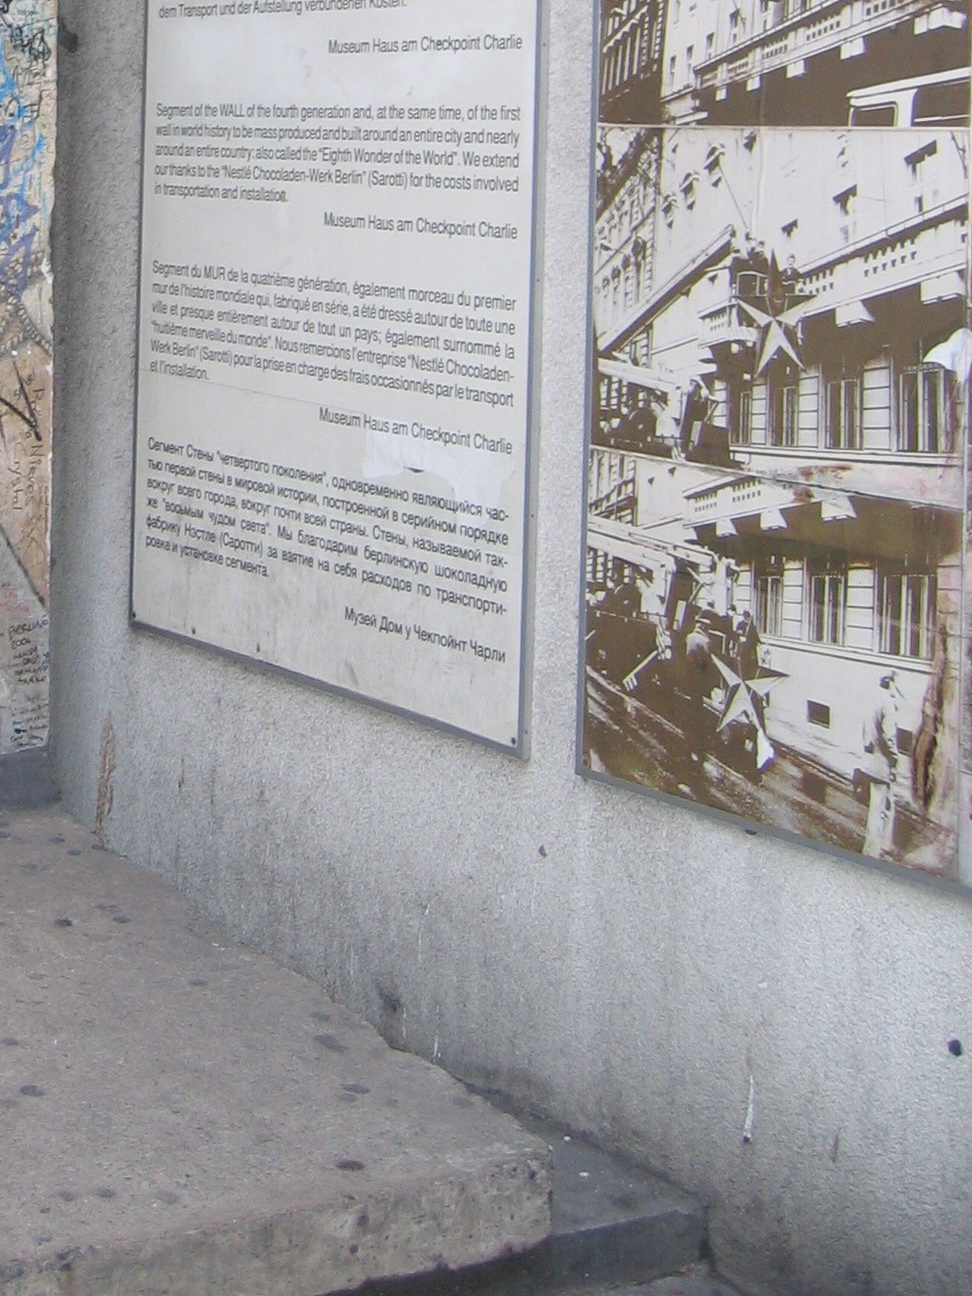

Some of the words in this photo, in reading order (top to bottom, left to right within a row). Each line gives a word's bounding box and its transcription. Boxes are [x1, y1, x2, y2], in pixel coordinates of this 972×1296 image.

[158, 5, 176, 18] dem
[178, 3, 218, 19] Transport
[219, 1, 235, 15] und
[237, 1, 252, 14] der
[252, 0, 302, 15] Aufstellung
[328, 39, 370, 53] Museum
[372, 38, 399, 52] Haus
[401, 40, 417, 51] am
[420, 35, 480, 54] Checkpoint
[483, 34, 522, 49] Charlie
[155, 103, 192, 119] Segment
[194, 103, 202, 116] of
[204, 103, 217, 116] the
[219, 103, 245, 117] WALL
[246, 104, 255, 117] of
[257, 104, 270, 117] the
[272, 104, 298, 118] fourth
[300, 104, 350, 121] generation
[352, 105, 374, 122] and,
[376, 106, 386, 119] at
[388, 105, 405, 119] the
[407, 108, 436, 120] same
[438, 105, 464, 123] time,
[466, 106, 478, 120] of
[480, 106, 497, 121] the
[500, 106, 521, 121] first
[323, 211, 365, 228] Museum
[367, 214, 394, 230] Haus
[396, 219, 413, 231] am
[415, 217, 475, 238] Checkpoint
[478, 222, 517, 239] Charlie
[152, 260, 188, 278] Segment
[190, 264, 201, 278] du
[203, 266, 225, 281] MUR
[227, 268, 238, 282] de
[240, 269, 248, 283] la
[251, 273, 295, 288] quatrième
[297, 275, 349, 297] génération,
[352, 281, 405, 300] également
[408, 289, 454, 305] morceau
[456, 291, 471, 307] du
[473, 295, 516, 312] premier
[319, 406, 361, 427] Museum
[363, 414, 389, 432] Haus
[391, 422, 408, 436] am
[411, 422, 470, 447] Checkpoint
[473, 433, 512, 454] Charlie
[147, 436, 183, 456] Сегмент
[185, 444, 213, 462] Стены
[485, 506, 509, 522] час-
[147, 458, 163, 471] тью
[164, 461, 196, 478] первой
[197, 468, 224, 484] стены
[226, 475, 232, 486] в
[234, 476, 274, 495] мировой
[276, 485, 319, 508] истории,
[392, 510, 398, 522] в
[401, 512, 456, 535] серийном
[459, 524, 508, 546] порядке
[344, 606, 376, 628] Музей
[379, 615, 403, 635] Дом
[404, 625, 412, 641] у
[413, 624, 467, 652] Чекпойнт
[469, 639, 506, 664] Чарли
